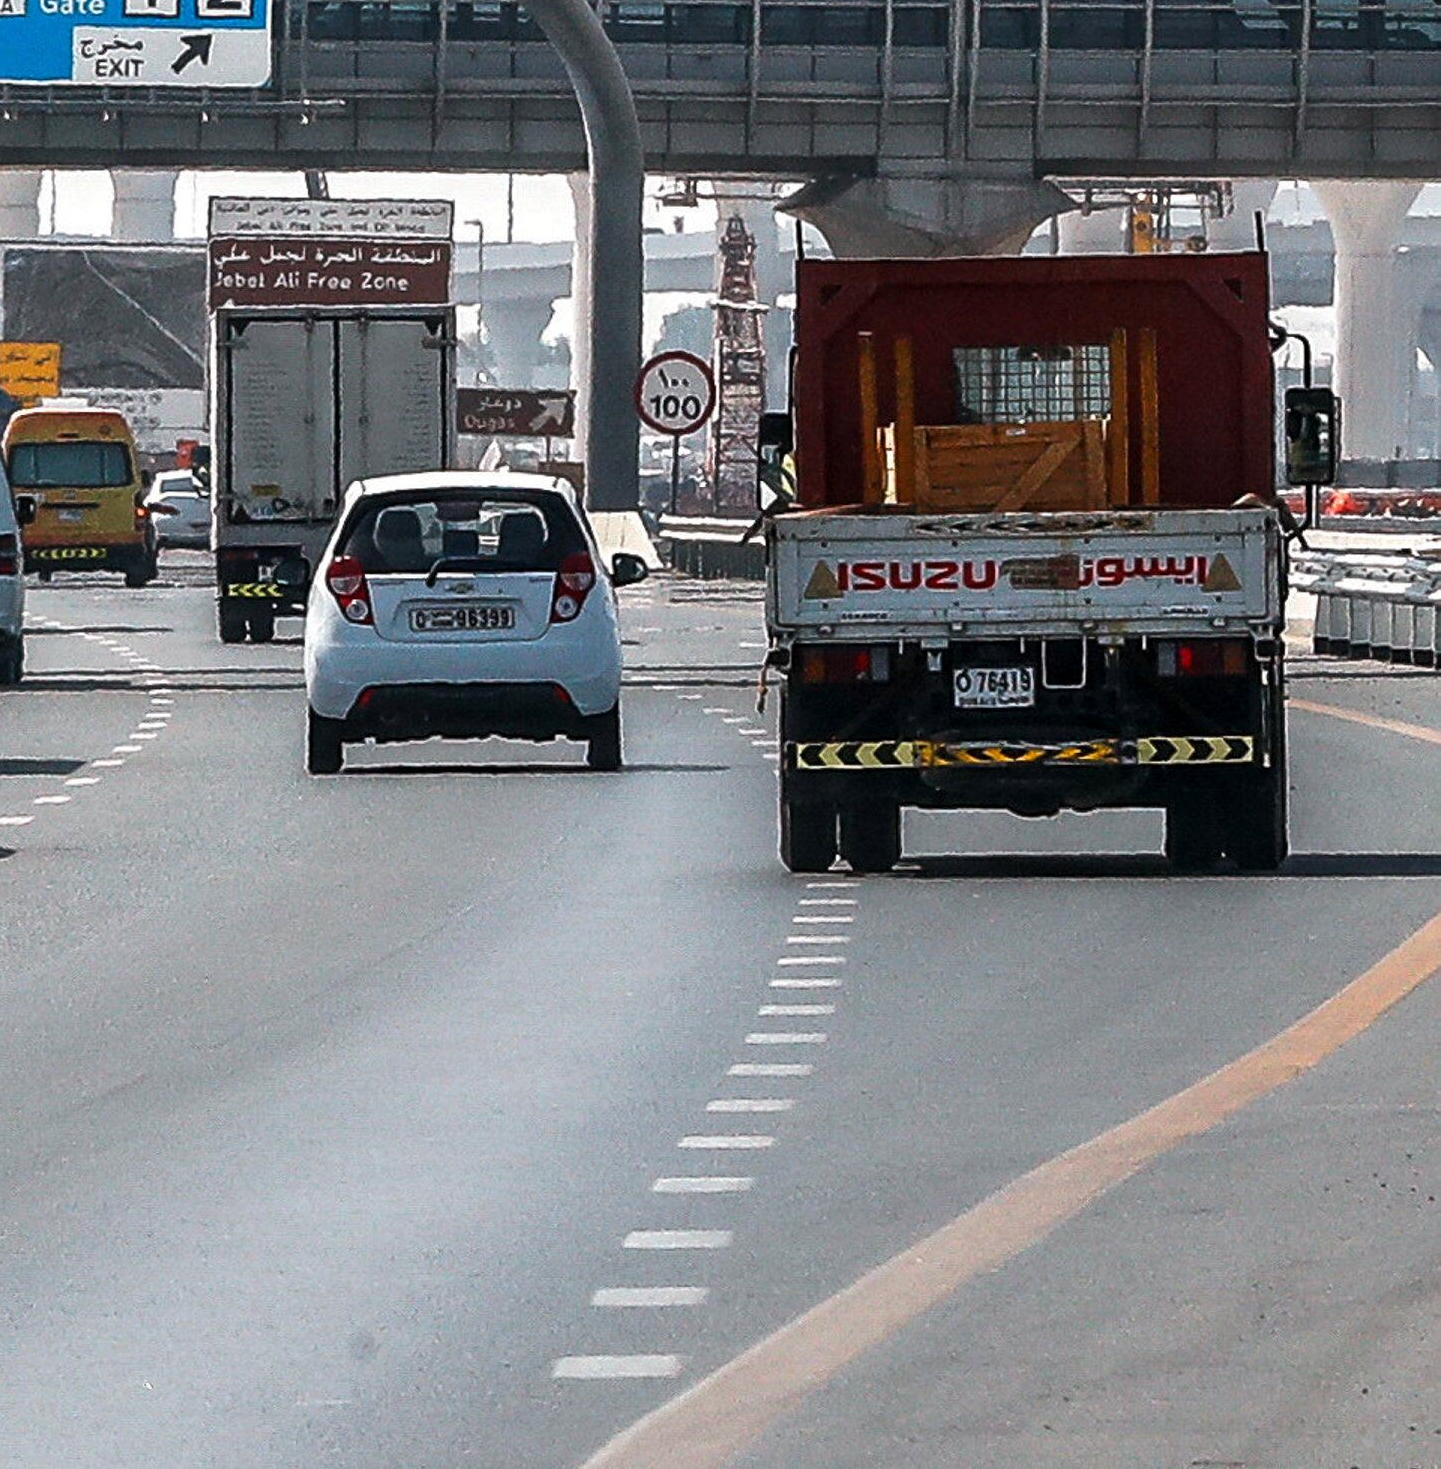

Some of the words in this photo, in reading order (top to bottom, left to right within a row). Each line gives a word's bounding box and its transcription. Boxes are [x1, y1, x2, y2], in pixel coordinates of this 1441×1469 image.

[80, 34, 144, 58] مخرج
[95, 58, 145, 77] EXIT
[214, 272, 265, 289] Jebel
[273, 272, 300, 288] Ali
[307, 272, 352, 289] Free
[361, 272, 410, 291] Zone
[650, 394, 702, 420] 100
[836, 559, 996, 591] ISUZU
[1078, 555, 1207, 588] ايسوز
